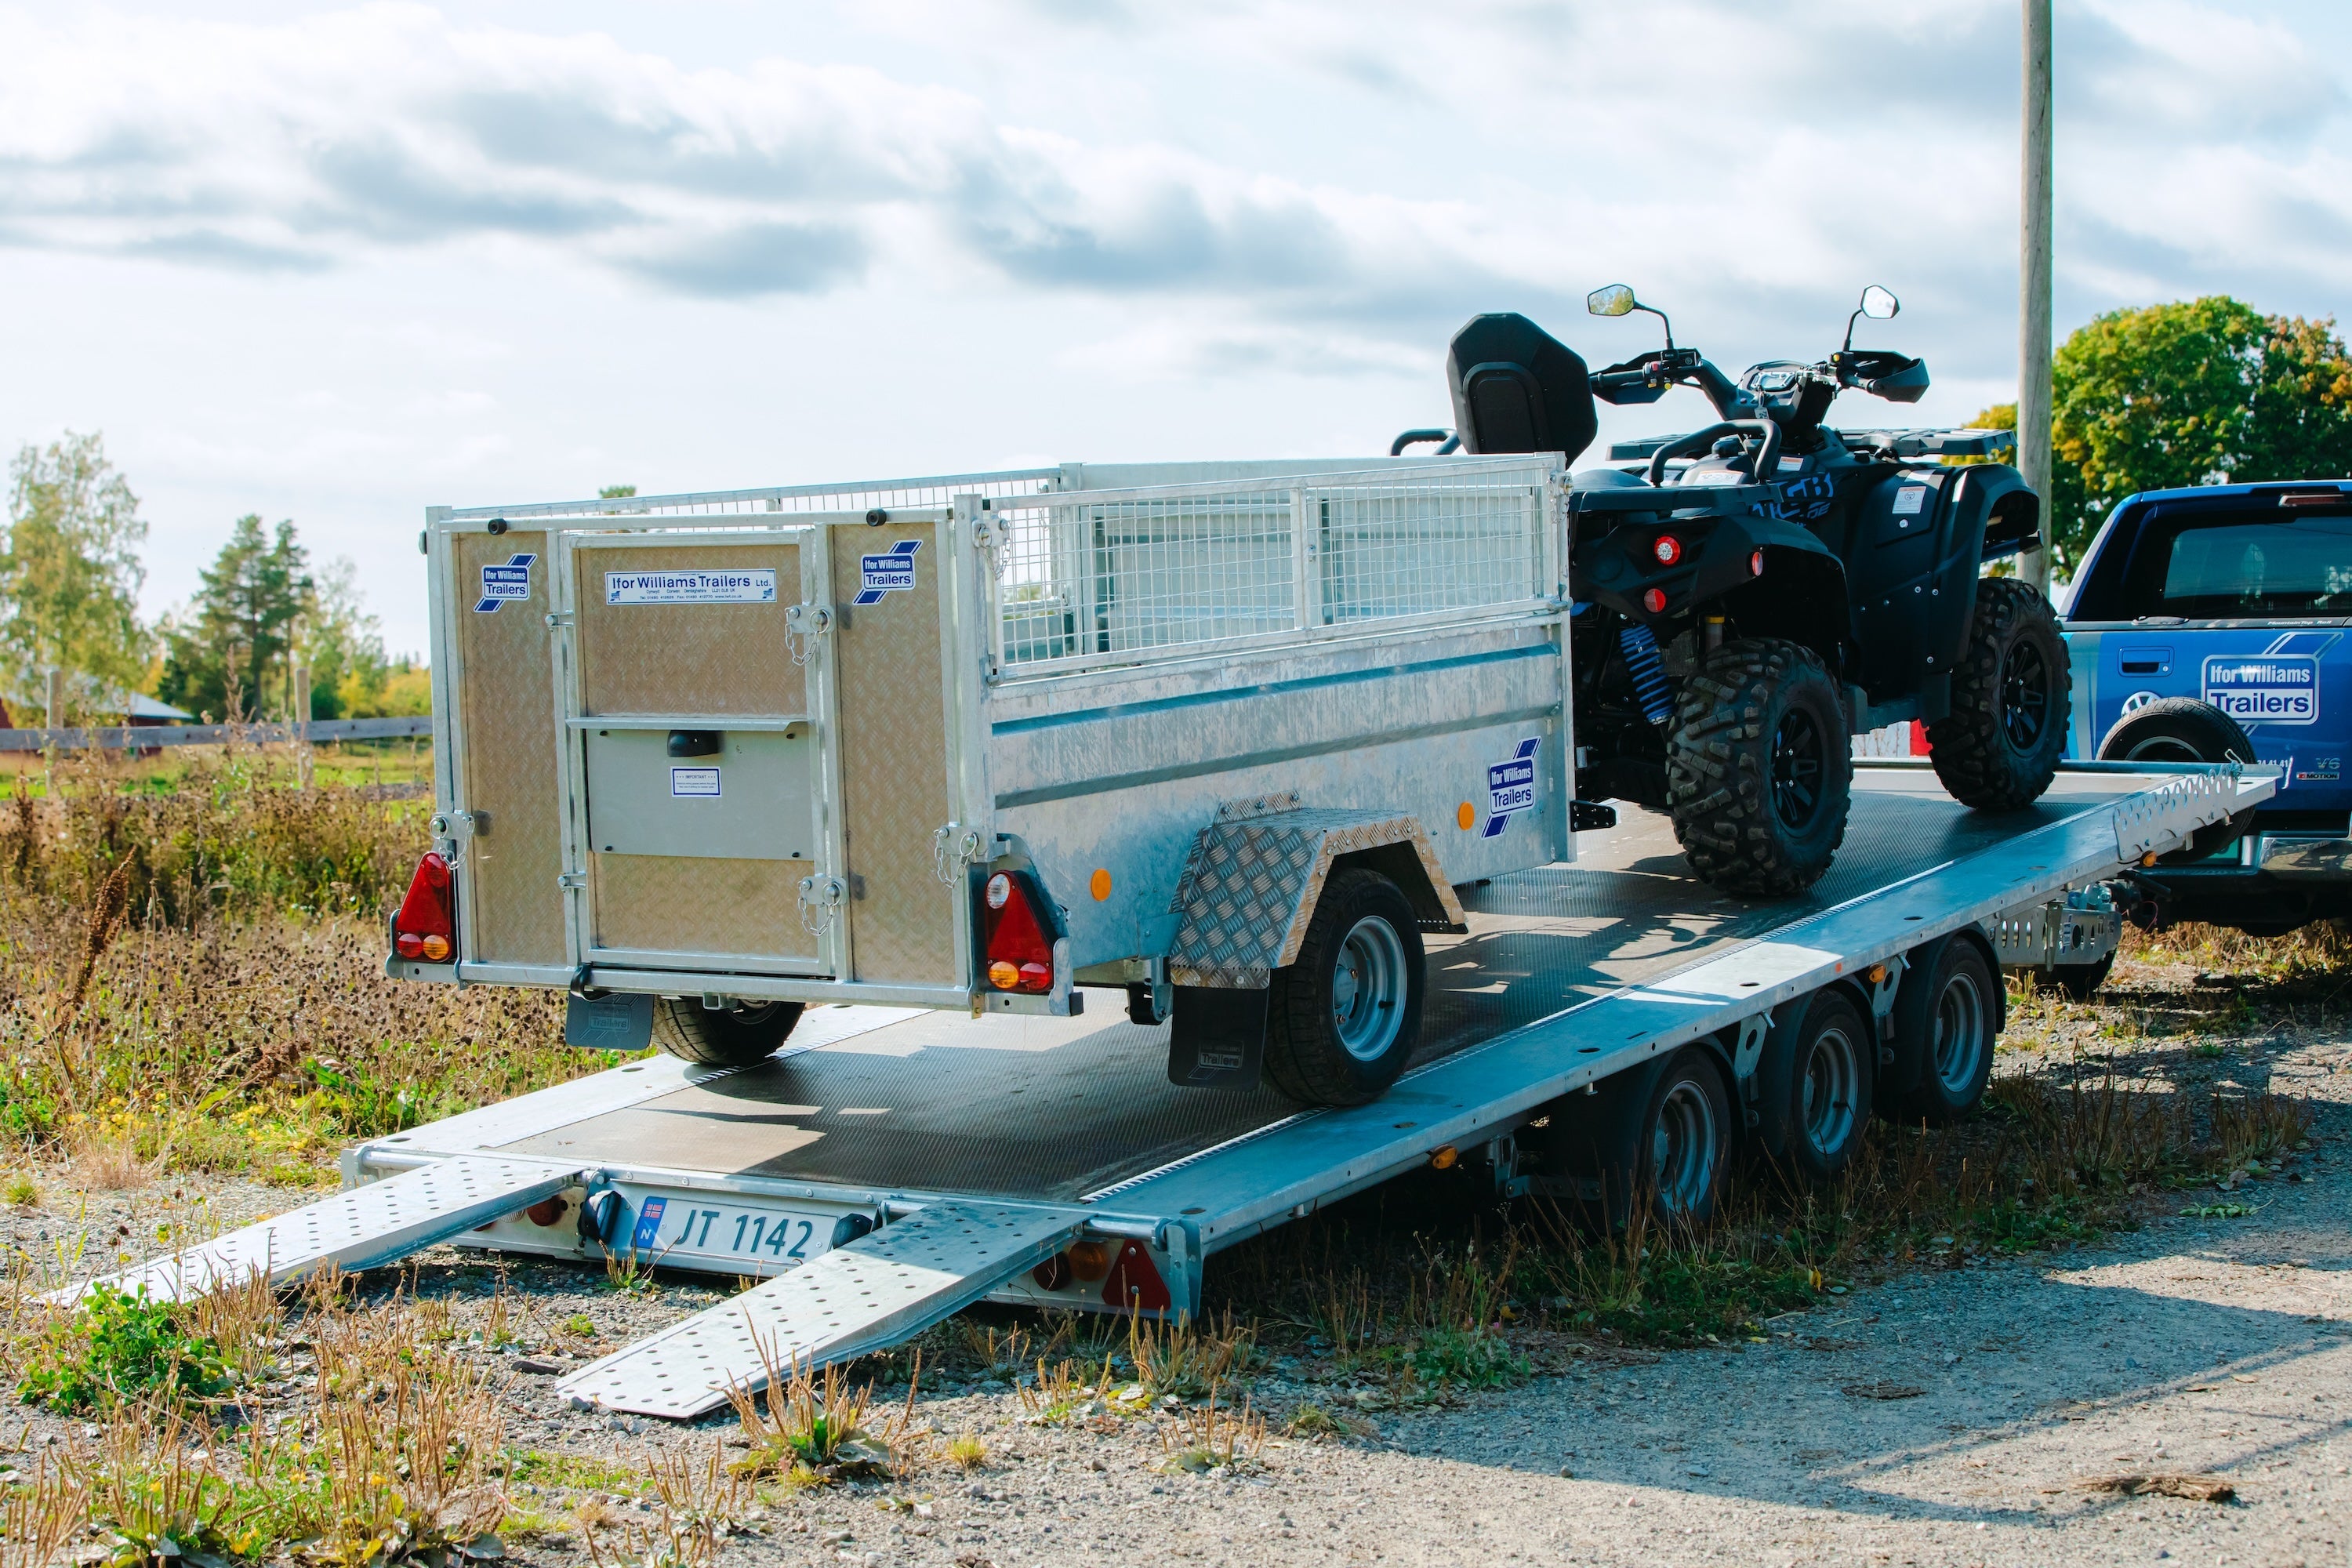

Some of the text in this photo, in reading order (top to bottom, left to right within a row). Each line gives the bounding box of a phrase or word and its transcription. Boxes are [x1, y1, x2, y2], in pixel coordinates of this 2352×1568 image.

[865, 559, 910, 570] Ifor Williams
[485, 571, 526, 580] Ifor Williams
[612, 578, 635, 589] Ifor
[637, 576, 696, 588] Williams
[699, 575, 750, 587] Trailers
[866, 574, 911, 585] Trailers
[486, 584, 526, 594] Trailers
[2210, 665, 2310, 683] Ifor Williams
[2210, 692, 2310, 713] Trailers
[2315, 757, 2341, 769] V6
[1491, 767, 1532, 786] Ifor Williams
[1493, 789, 1532, 808] Trailers
[640, 1229, 652, 1240] N
[676, 1209, 813, 1258] JT 1142
